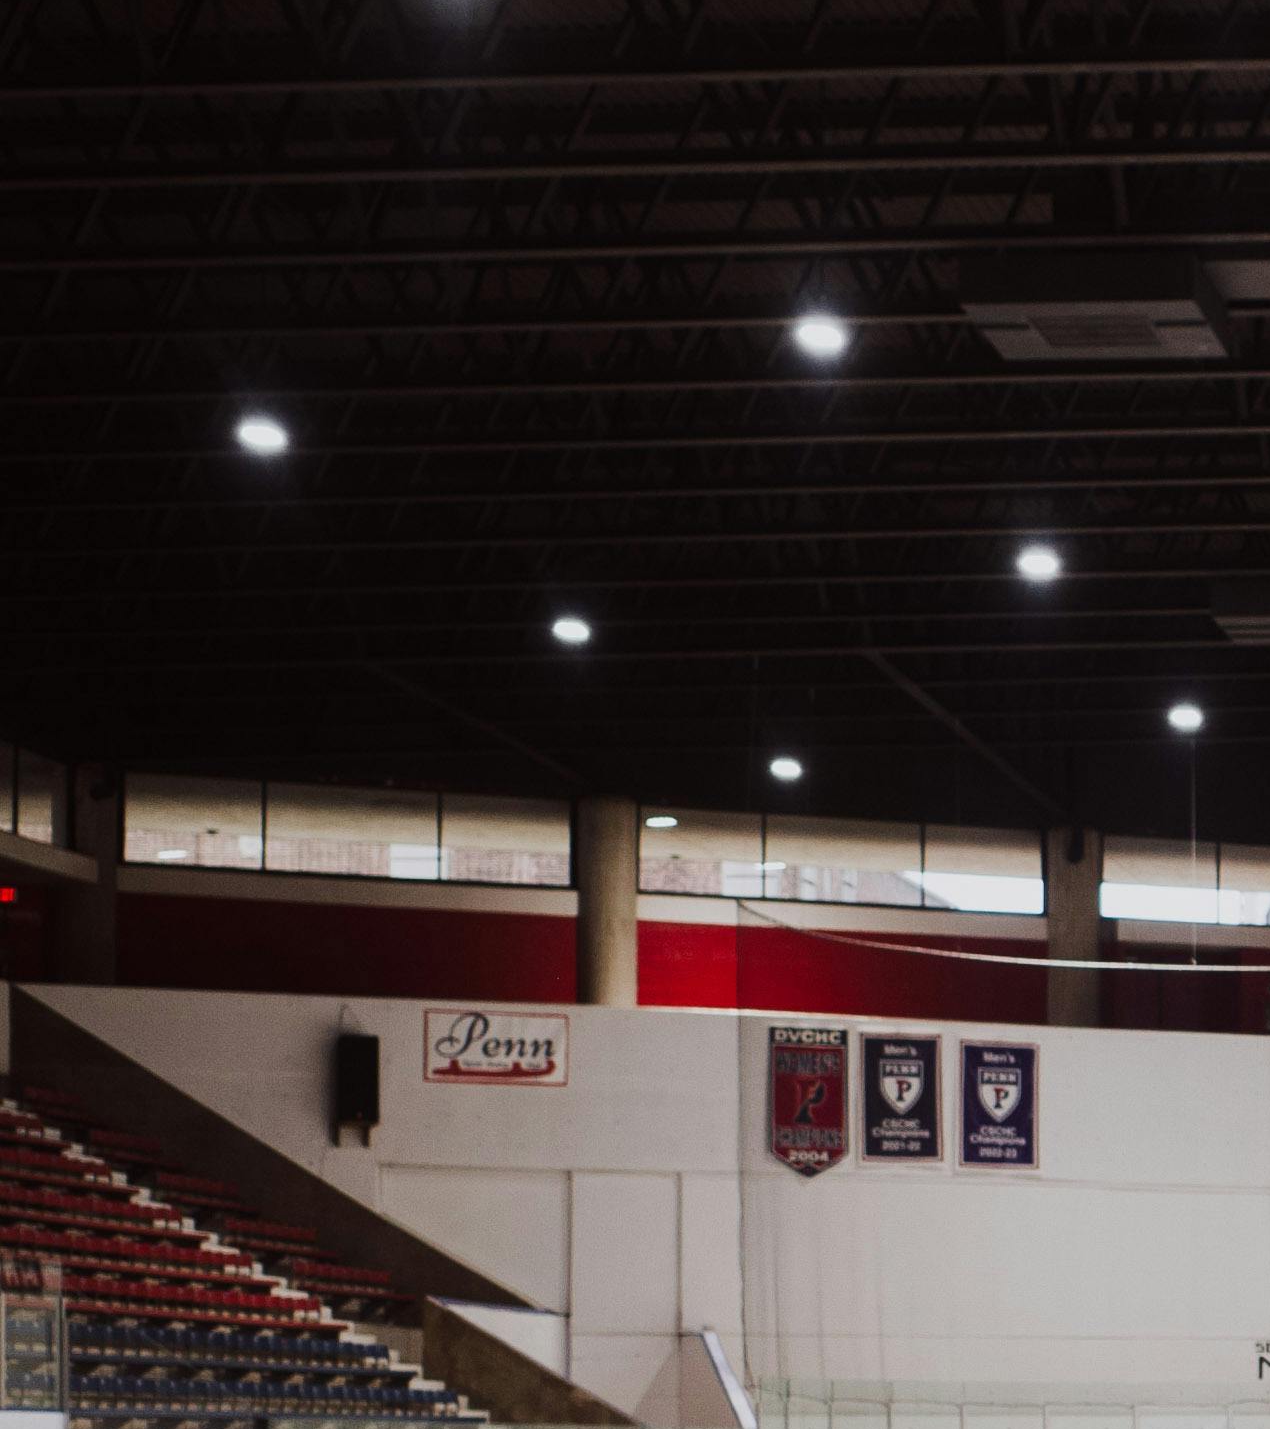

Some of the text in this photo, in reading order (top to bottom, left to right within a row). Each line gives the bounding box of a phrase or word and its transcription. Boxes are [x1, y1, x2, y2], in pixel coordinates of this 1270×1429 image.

[434, 1012, 554, 1058] Penn
[883, 1043, 917, 1056] Men's
[983, 1051, 1016, 1064] Men's
[884, 1064, 919, 1075] PENN
[982, 1072, 1017, 1083] PENN
[896, 1078, 912, 1102] P
[993, 1086, 1009, 1109] P
[871, 1127, 930, 1139] Champions
[969, 1134, 1027, 1146] Champions
[788, 1149, 830, 1163] 2004
